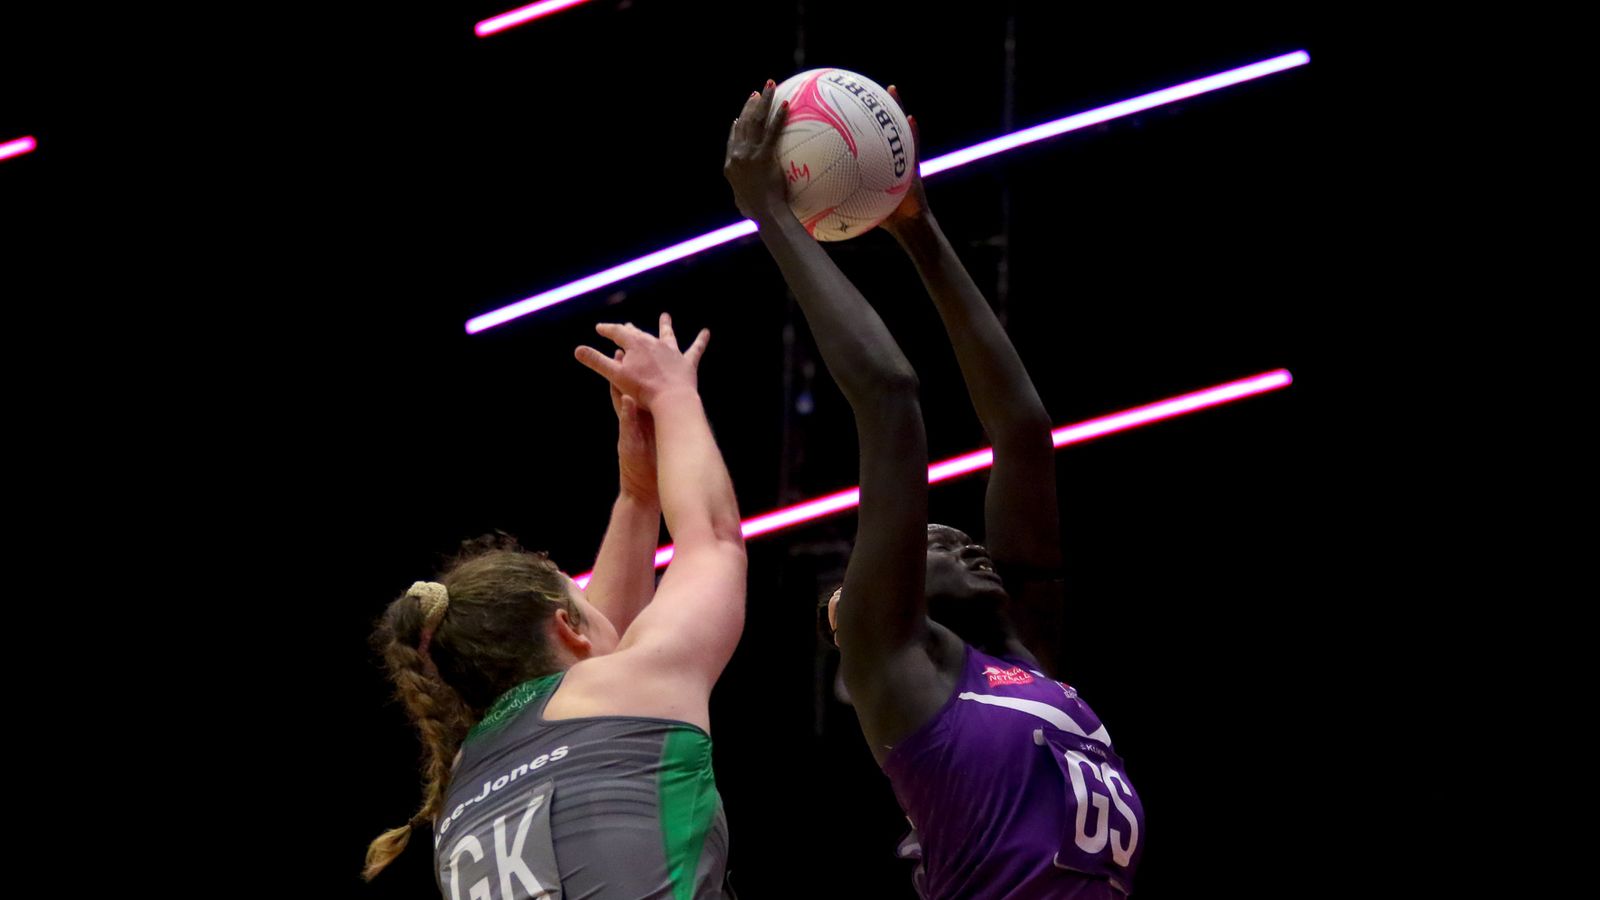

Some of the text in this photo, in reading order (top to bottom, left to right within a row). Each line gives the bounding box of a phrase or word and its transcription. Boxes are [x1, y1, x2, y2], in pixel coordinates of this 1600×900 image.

[786, 159, 810, 185] ity
[828, 74, 906, 178] GILBERT
[449, 794, 545, 900] GK
[1064, 750, 1139, 867] GS
